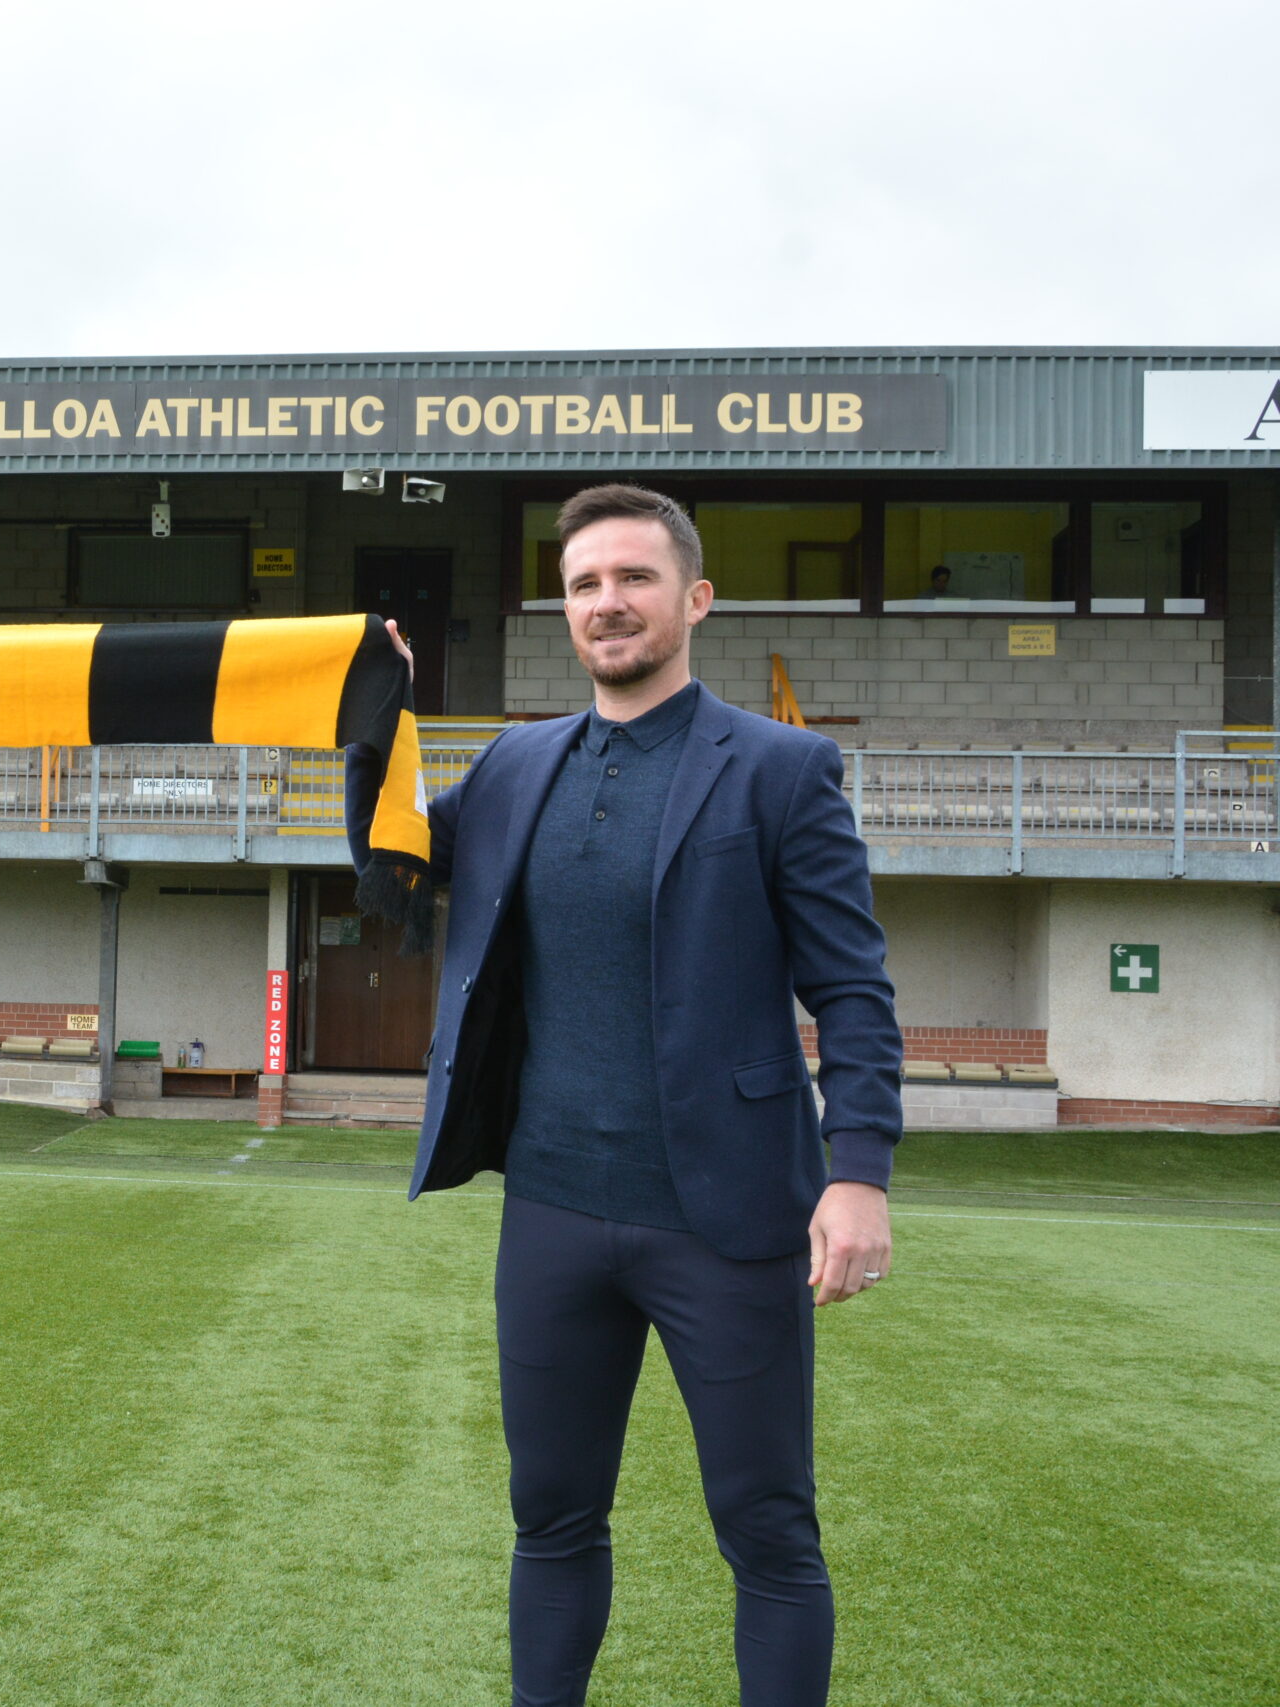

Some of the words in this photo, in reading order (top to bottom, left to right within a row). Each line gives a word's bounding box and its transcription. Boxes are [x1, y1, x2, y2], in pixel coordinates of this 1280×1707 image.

[135, 395, 385, 437] ATHLETIC
[415, 394, 694, 436] FOOTBALL
[717, 392, 863, 433] CLUB
[265, 554, 283, 562] HOME
[268, 748, 278, 760] C
[1255, 842, 1265, 853] A
[271, 974, 282, 1012] RED
[70, 1015, 96, 1023] HOME
[269, 1020, 281, 1070] ZONE
